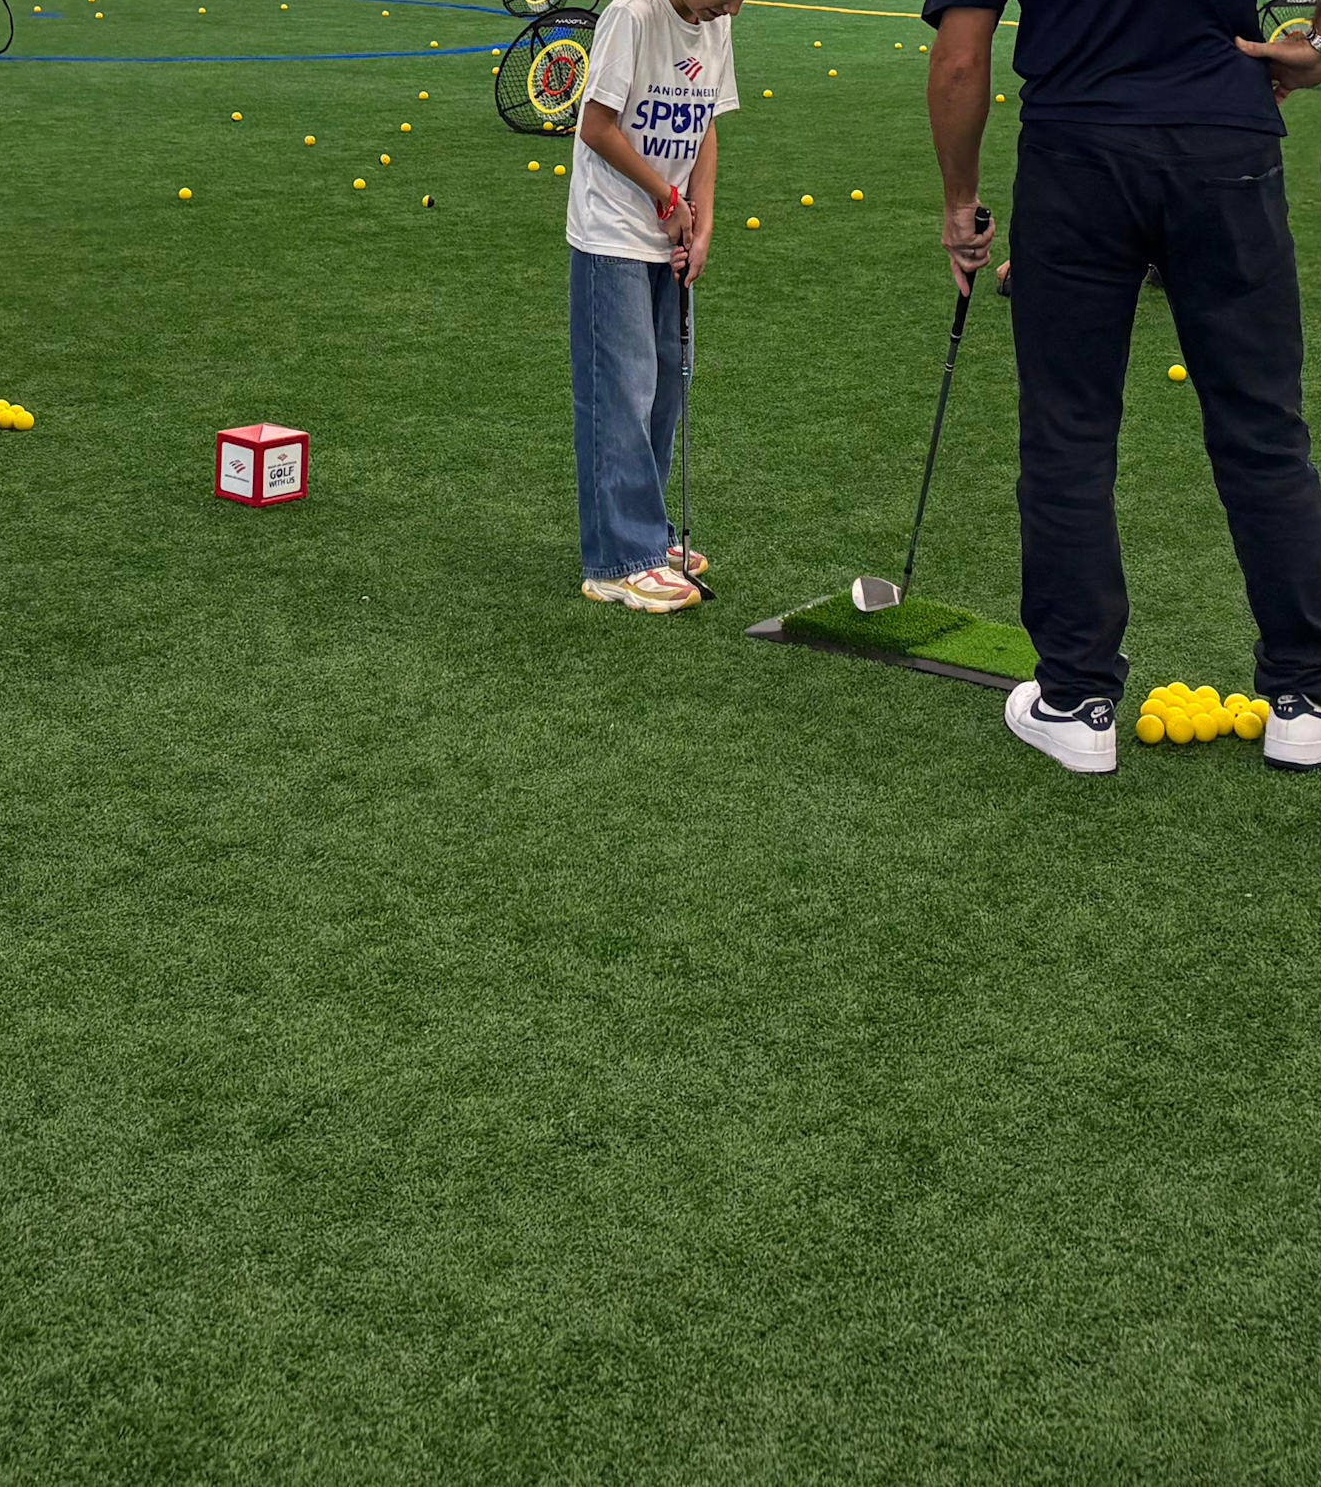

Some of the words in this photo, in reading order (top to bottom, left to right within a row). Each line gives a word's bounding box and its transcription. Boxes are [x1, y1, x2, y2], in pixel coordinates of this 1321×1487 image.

[675, 87, 690, 97] OF
[643, 135, 698, 160] WITH
[269, 465, 295, 480] GOLF
